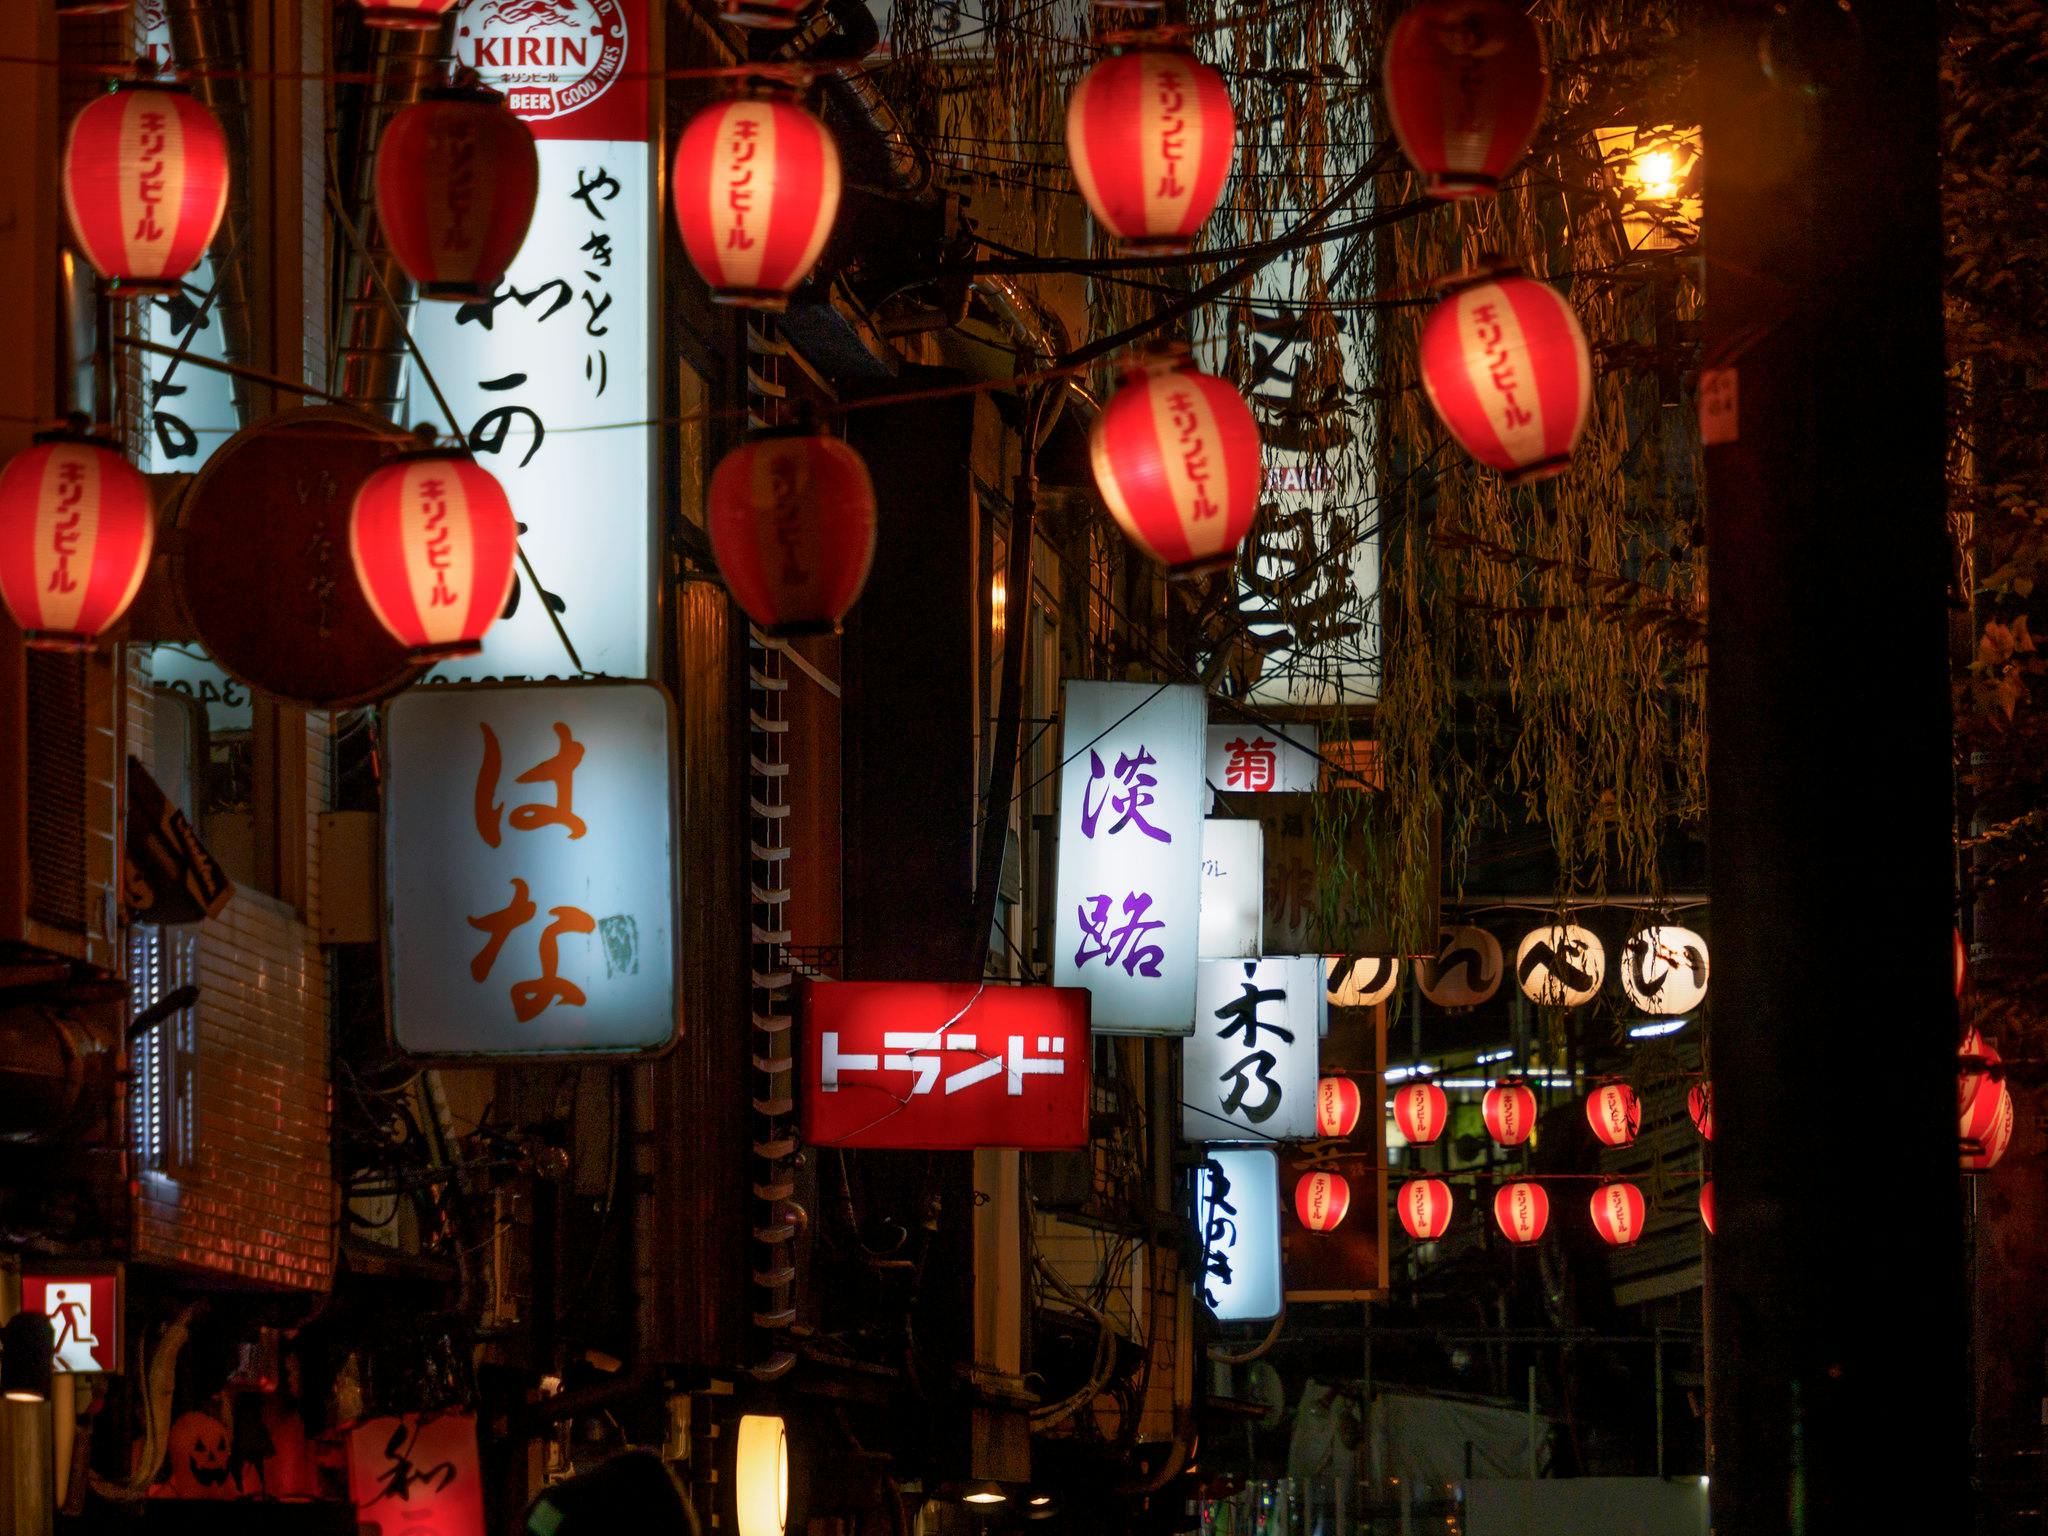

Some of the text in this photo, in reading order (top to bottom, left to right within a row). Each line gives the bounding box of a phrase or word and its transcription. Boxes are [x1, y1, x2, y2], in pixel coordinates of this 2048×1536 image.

[474, 37, 587, 67] KIRIN
[510, 45, 621, 110] BEER GOOD TIMES
[134, 113, 164, 242] キリンビール
[727, 120, 758, 250] キリンビール
[1158, 72, 1185, 199] キリンビール
[571, 166, 622, 399] やきとり
[1472, 304, 1532, 430] キリンビール
[1167, 391, 1217, 523] キリンビール
[48, 462, 85, 594] キリンビール
[419, 479, 457, 609] キリンビール
[1224, 737, 1277, 792] 菊
[467, 721, 596, 1025] はな
[1074, 745, 1171, 979] 淡路
[821, 1030, 1065, 1096] トランド
